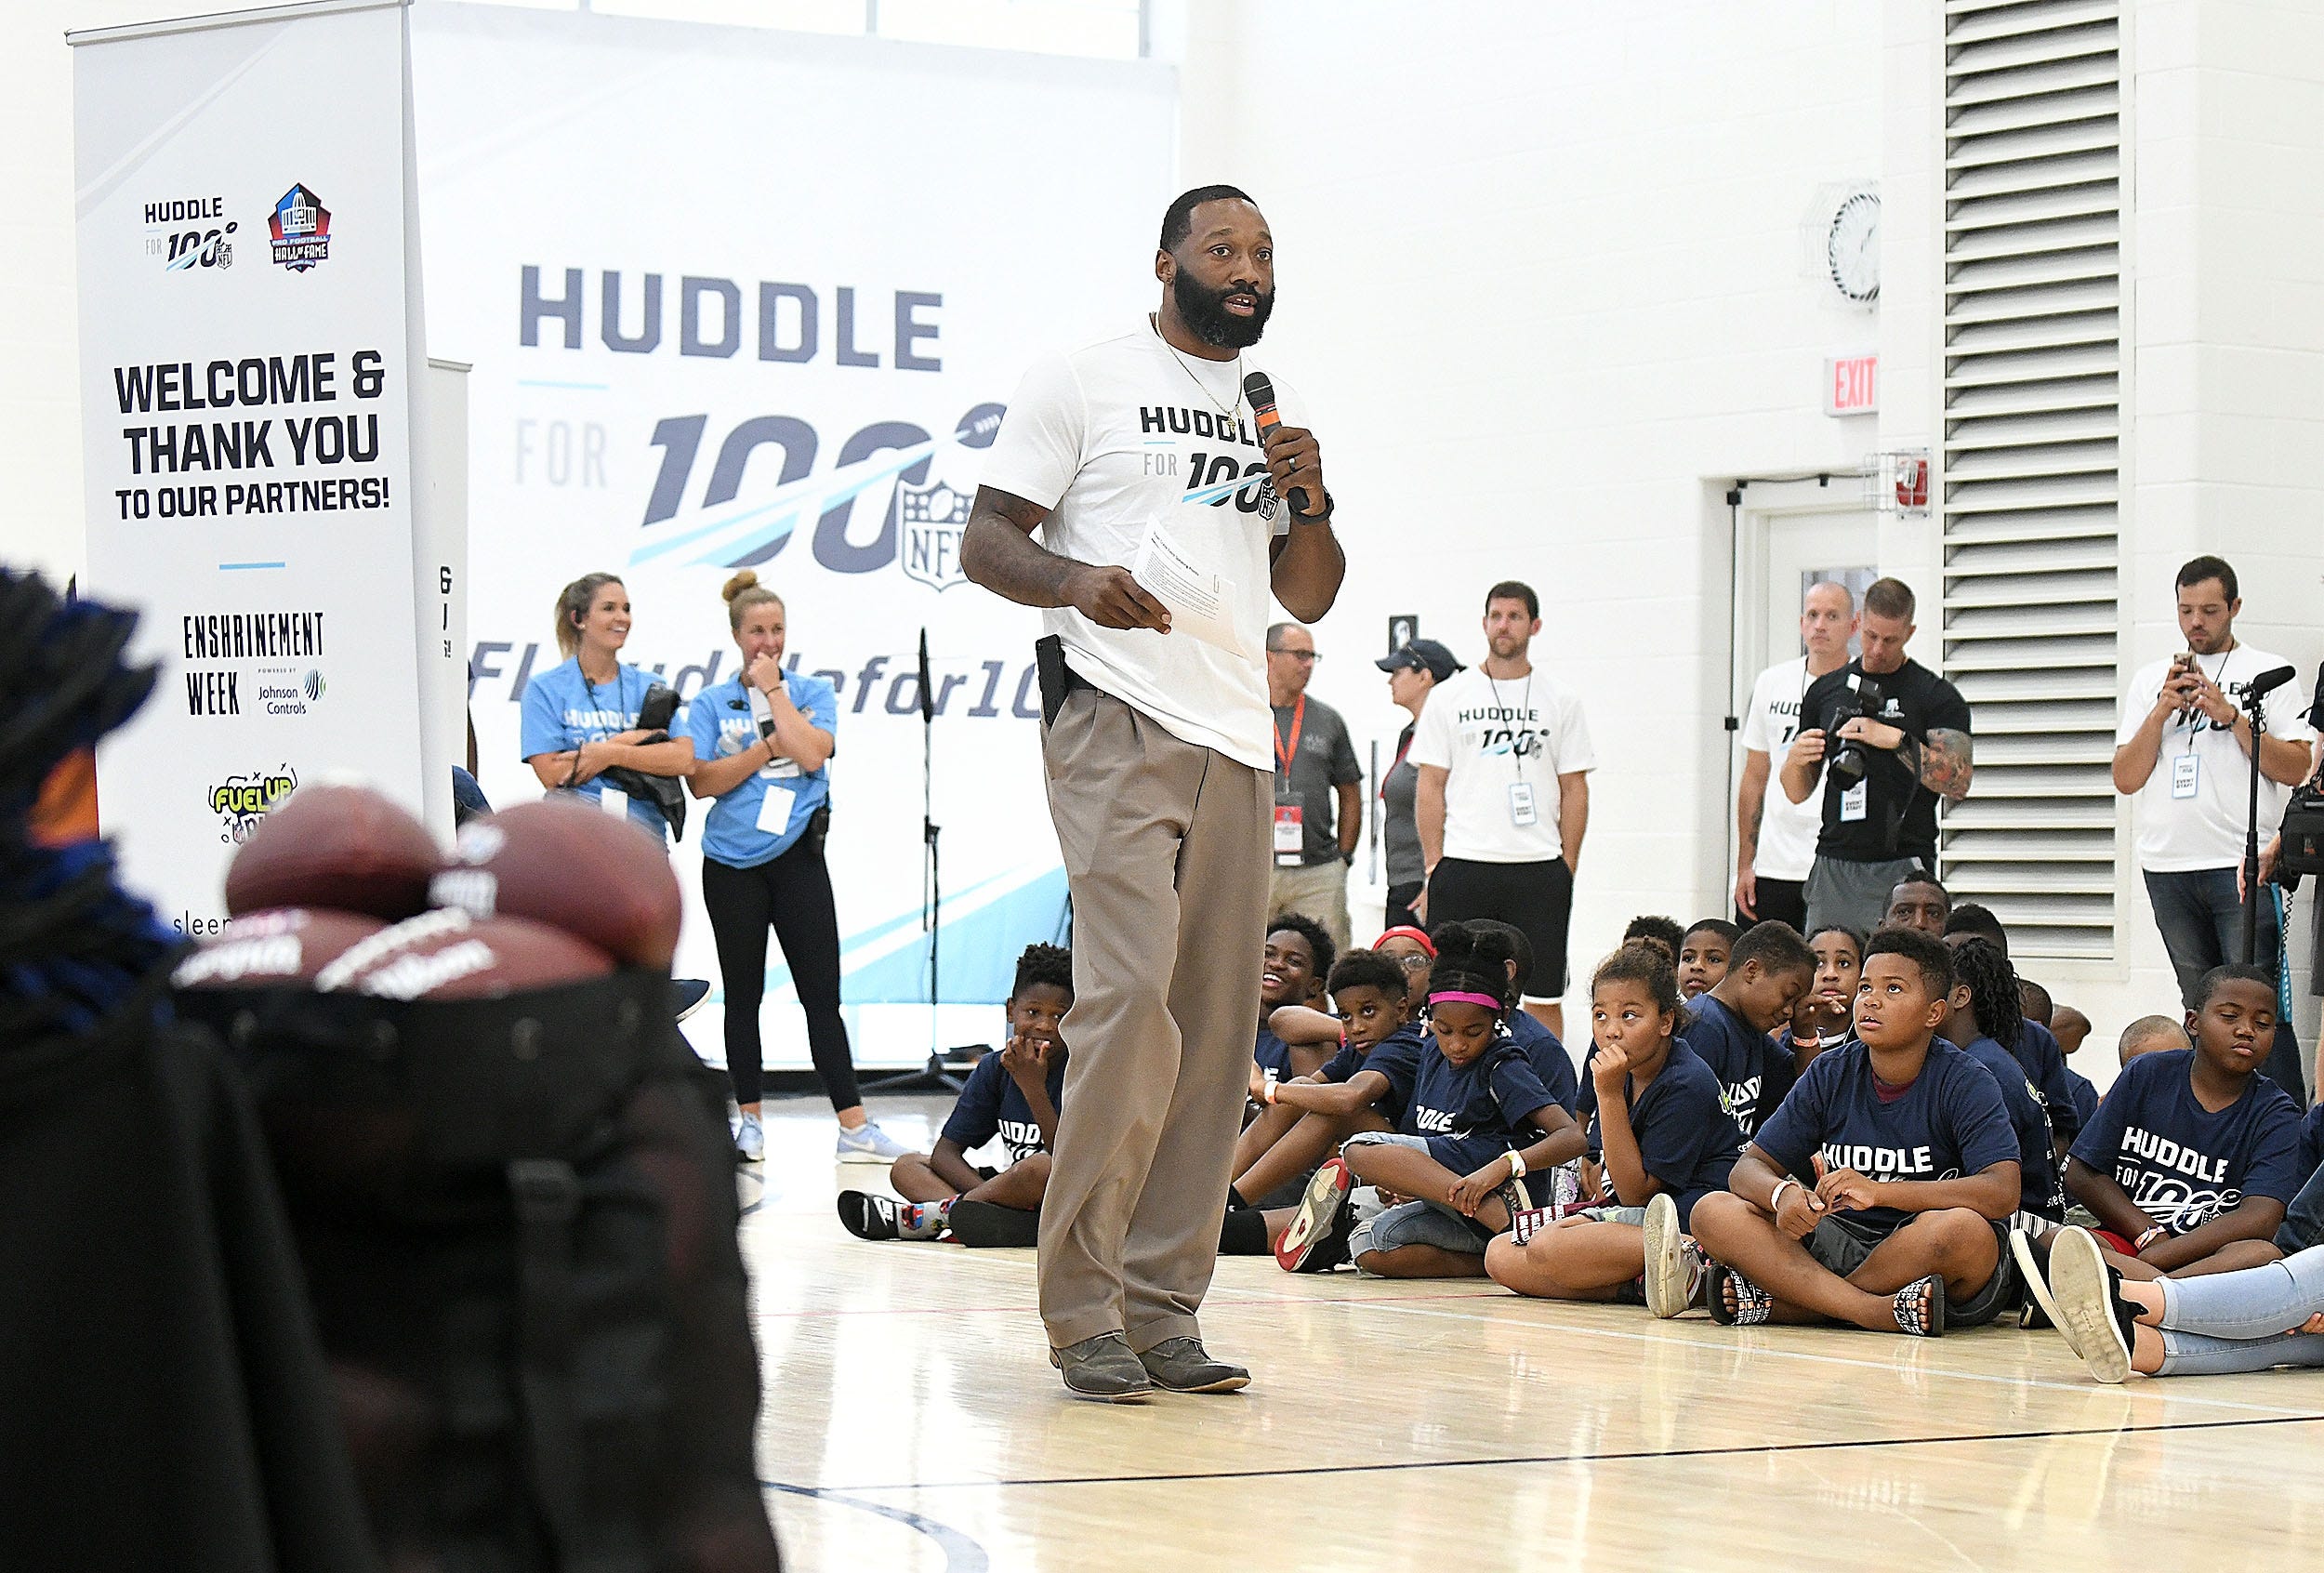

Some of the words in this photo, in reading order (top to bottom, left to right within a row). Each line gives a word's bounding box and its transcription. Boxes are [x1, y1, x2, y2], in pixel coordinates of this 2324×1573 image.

[145, 197, 223, 223] HUDDLE
[145, 238, 163, 256] FOR
[275, 245, 297, 261] HALL
[304, 243, 327, 259] FAME
[289, 235, 328, 245] FOOTBALL
[519, 265, 943, 372] HUDDLE
[113, 352, 337, 415] WELCOME
[351, 350, 385, 400] &
[1834, 357, 1878, 410] EXIT
[124, 418, 275, 475] THANK
[284, 414, 379, 467] YOU
[1140, 407, 1266, 448] HUDDL
[513, 416, 608, 490] FOR
[1143, 453, 1178, 477] FOR
[114, 488, 150, 521] TO
[158, 484, 218, 519] OUR
[225, 477, 390, 516] PARTNERS!
[183, 612, 324, 659] ENSHRINEMENT
[186, 671, 240, 717] WEEK
[258, 685, 298, 700] Johnson
[267, 701, 307, 715] Controls
[1769, 701, 1801, 717] HUD
[1459, 707, 1539, 723] HUDDLE
[214, 786, 272, 814] FUEL
[264, 777, 293, 802] UP
[997, 1118, 1042, 1144] UDD
[1822, 1142, 1934, 1173] HUDDLE
[2120, 1126, 2229, 1183] HUDDLE
